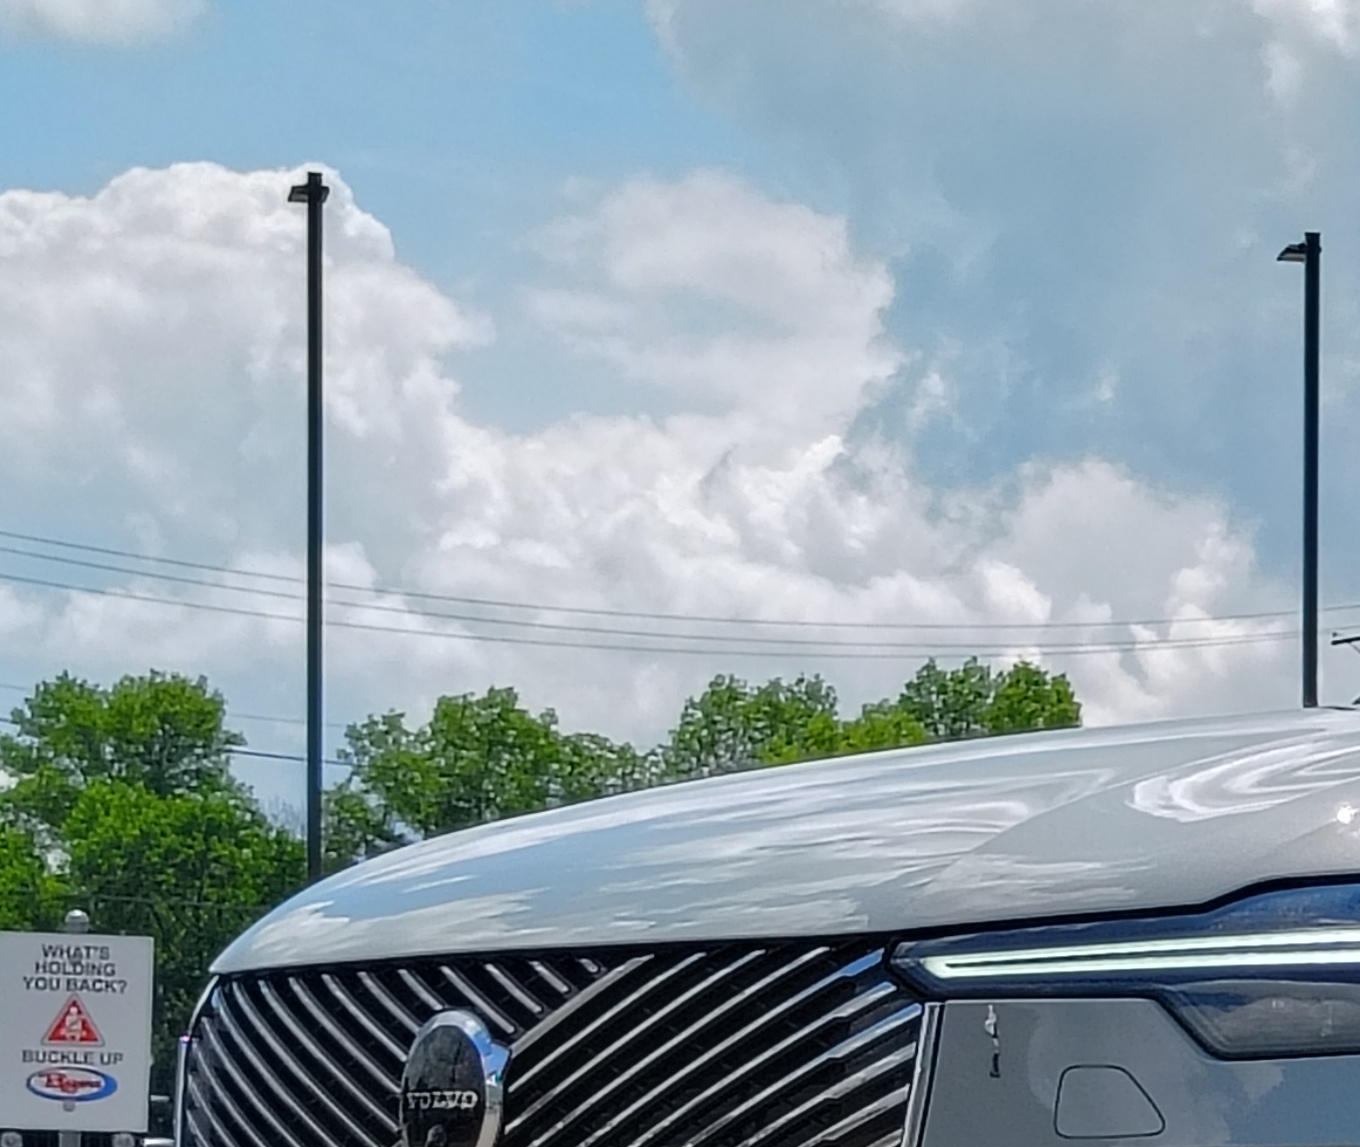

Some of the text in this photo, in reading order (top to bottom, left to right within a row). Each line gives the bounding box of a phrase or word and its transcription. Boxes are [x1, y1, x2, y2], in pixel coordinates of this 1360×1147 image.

[41, 943, 110, 960] WHAT'S
[34, 961, 116, 977] HOLDING
[23, 976, 128, 994] YOU BACK?
[22, 1050, 123, 1066] BUCKLE UP
[406, 1090, 478, 1110] VOLVO
